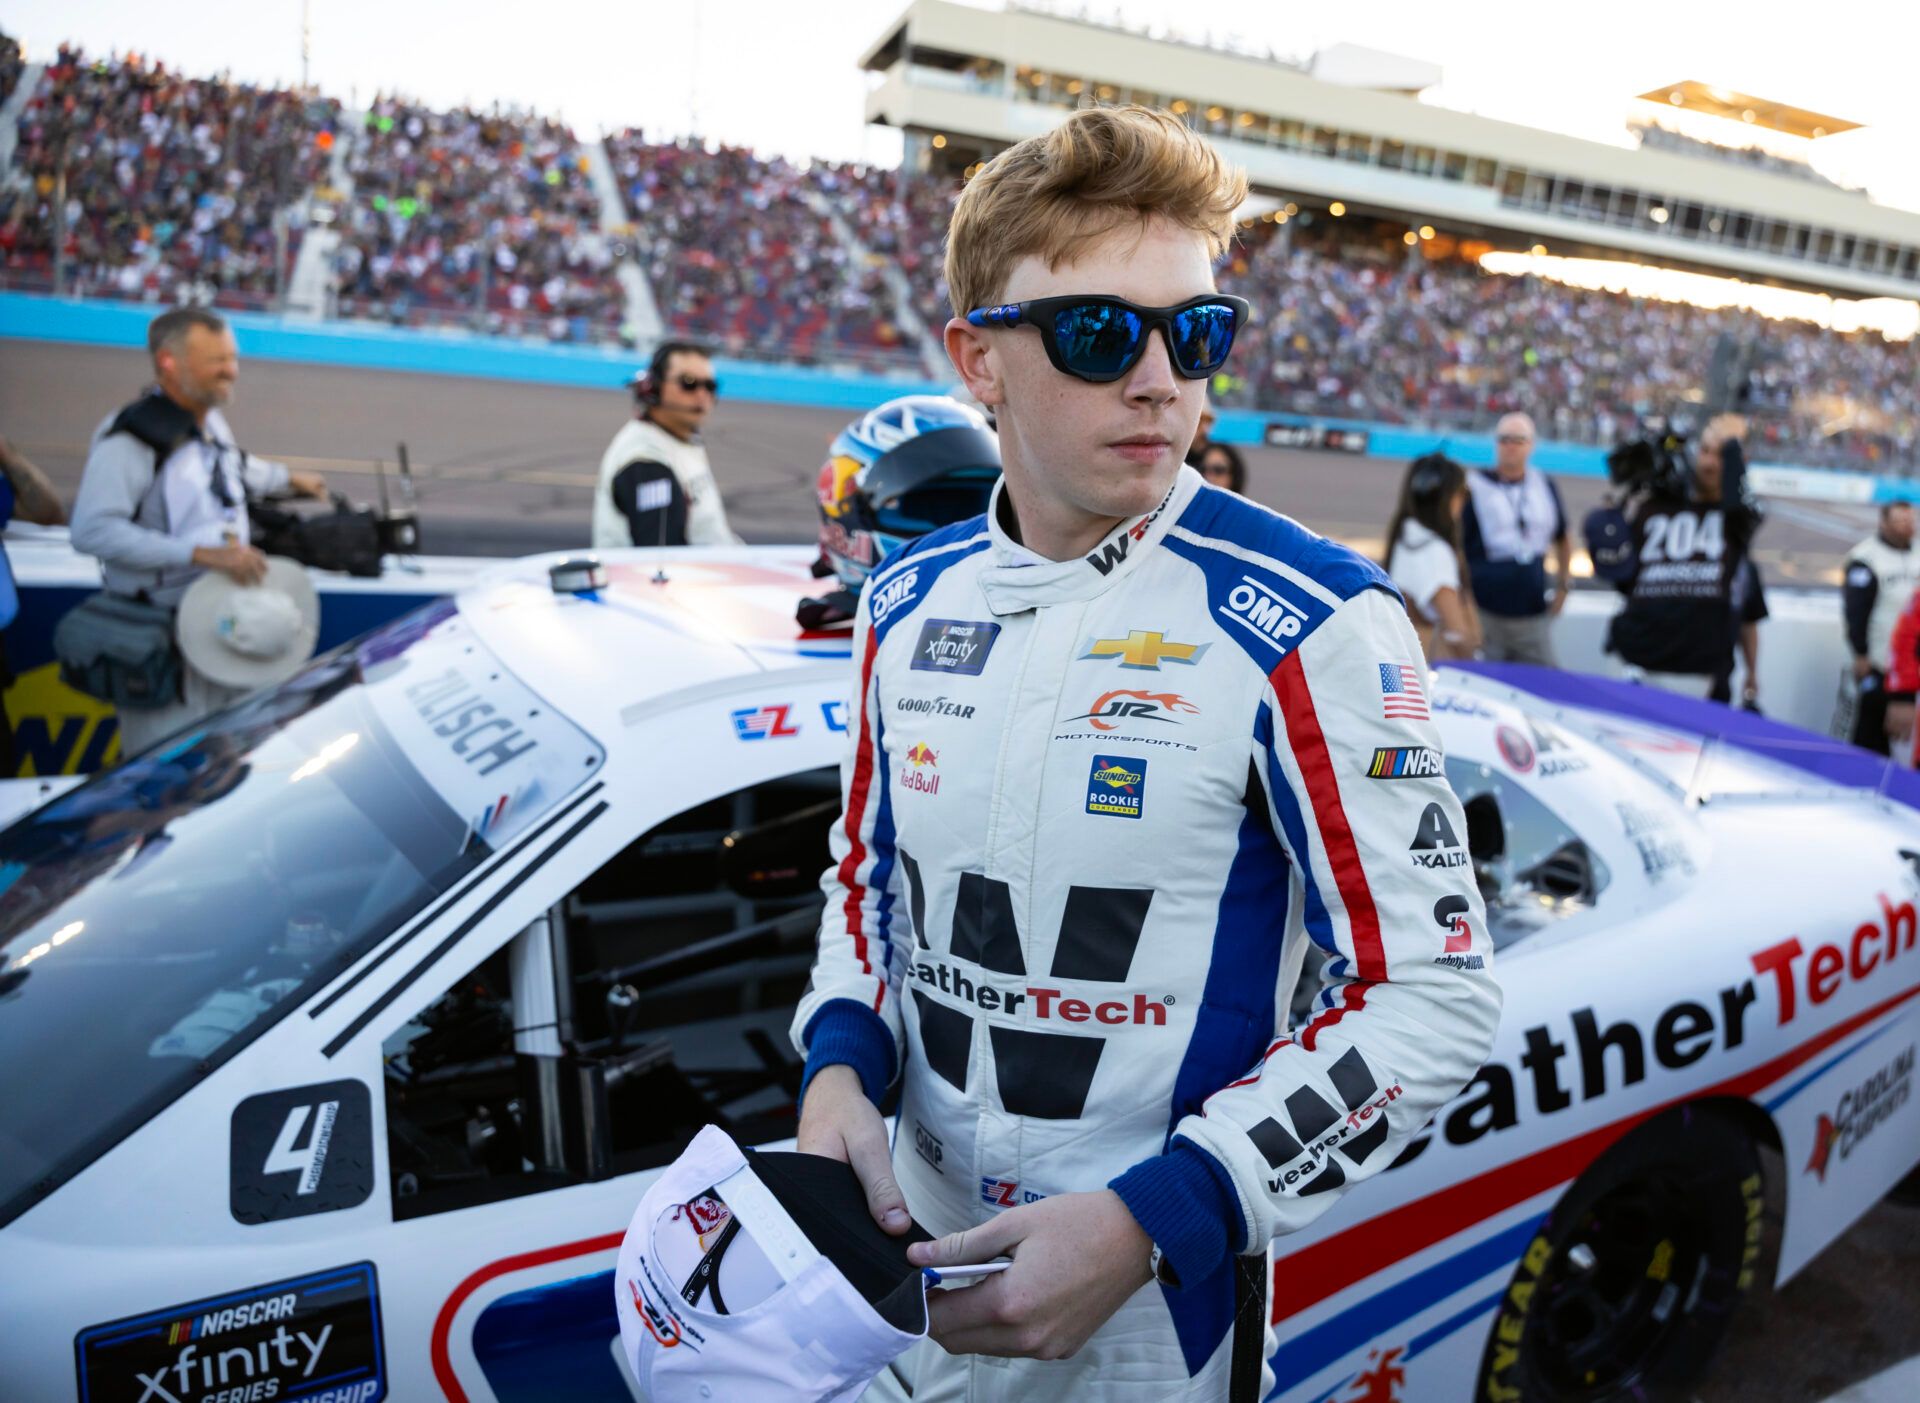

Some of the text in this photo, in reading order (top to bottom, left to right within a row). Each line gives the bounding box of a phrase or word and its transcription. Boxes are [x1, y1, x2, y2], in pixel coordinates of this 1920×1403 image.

[1639, 510, 1725, 561] 204
[874, 573, 918, 618] OMP
[1228, 585, 1301, 640] OMP
[925, 636, 979, 663] xfinity
[1054, 733, 1200, 752] MOTORSPORTS
[1402, 749, 1442, 775] NAS
[1095, 769, 1140, 785] SUNOCO
[1090, 793, 1140, 807] ROOKIE
[263, 1101, 340, 1196] 4
[915, 1127, 943, 1165] OMP
[1267, 1084, 1403, 1194] WeaherTech
[201, 1294, 297, 1337] NASCAR
[135, 1324, 333, 1403] xfinity
